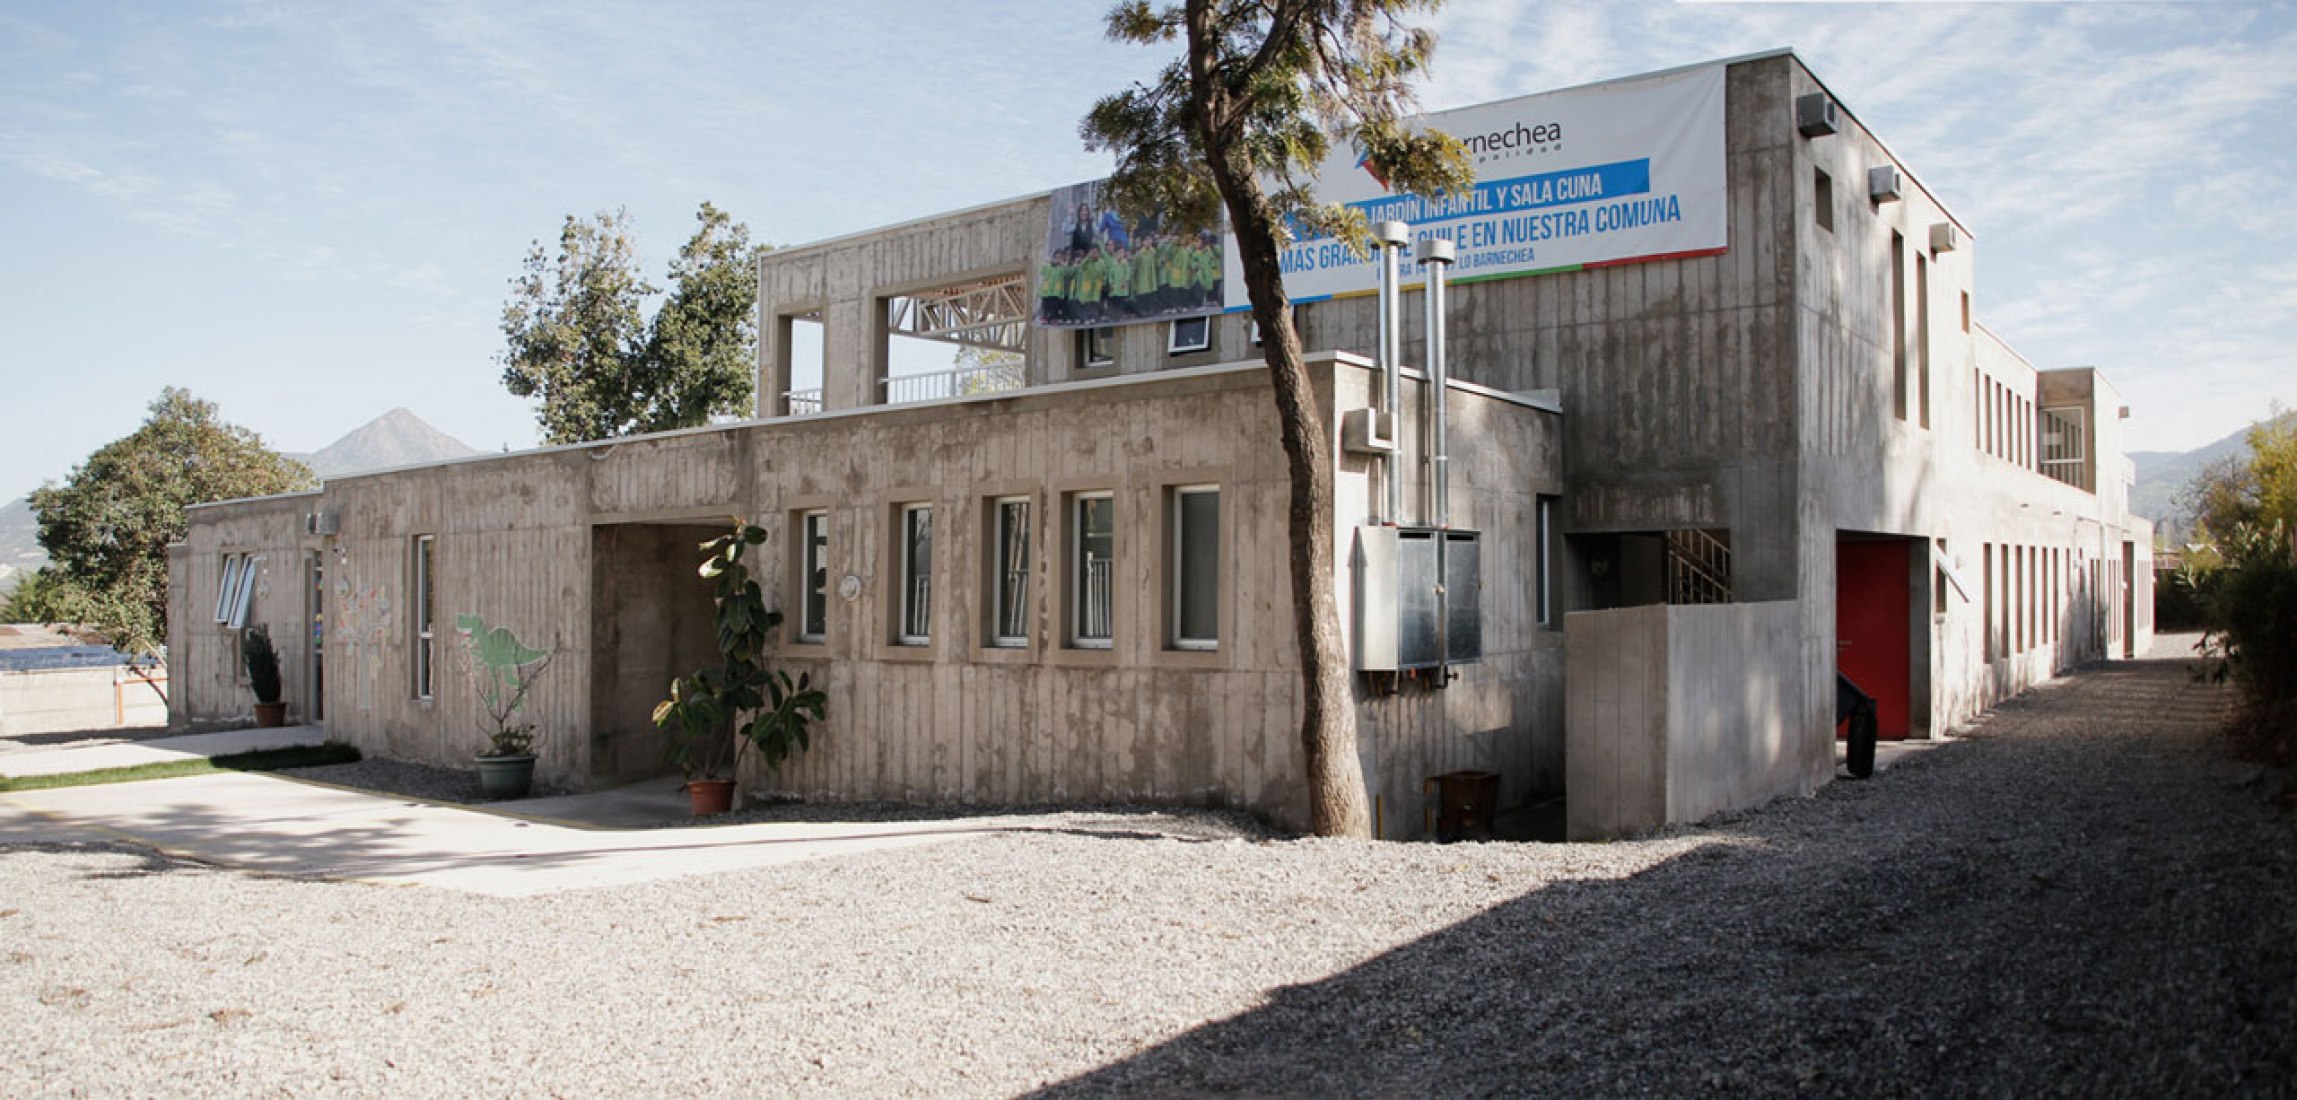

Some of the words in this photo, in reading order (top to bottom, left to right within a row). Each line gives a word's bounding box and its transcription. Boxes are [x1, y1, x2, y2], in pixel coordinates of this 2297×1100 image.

[1462, 121, 1561, 154] rnechea
[1496, 186, 1508, 209] Y
[1511, 178, 1553, 207] SALA
[1557, 172, 1603, 200] CUNA
[1472, 219, 1497, 248] EN
[1502, 209, 1590, 246] NUESTRA
[1595, 194, 1681, 233] COMUNA
[1472, 247, 1535, 268] BARNECHEA
